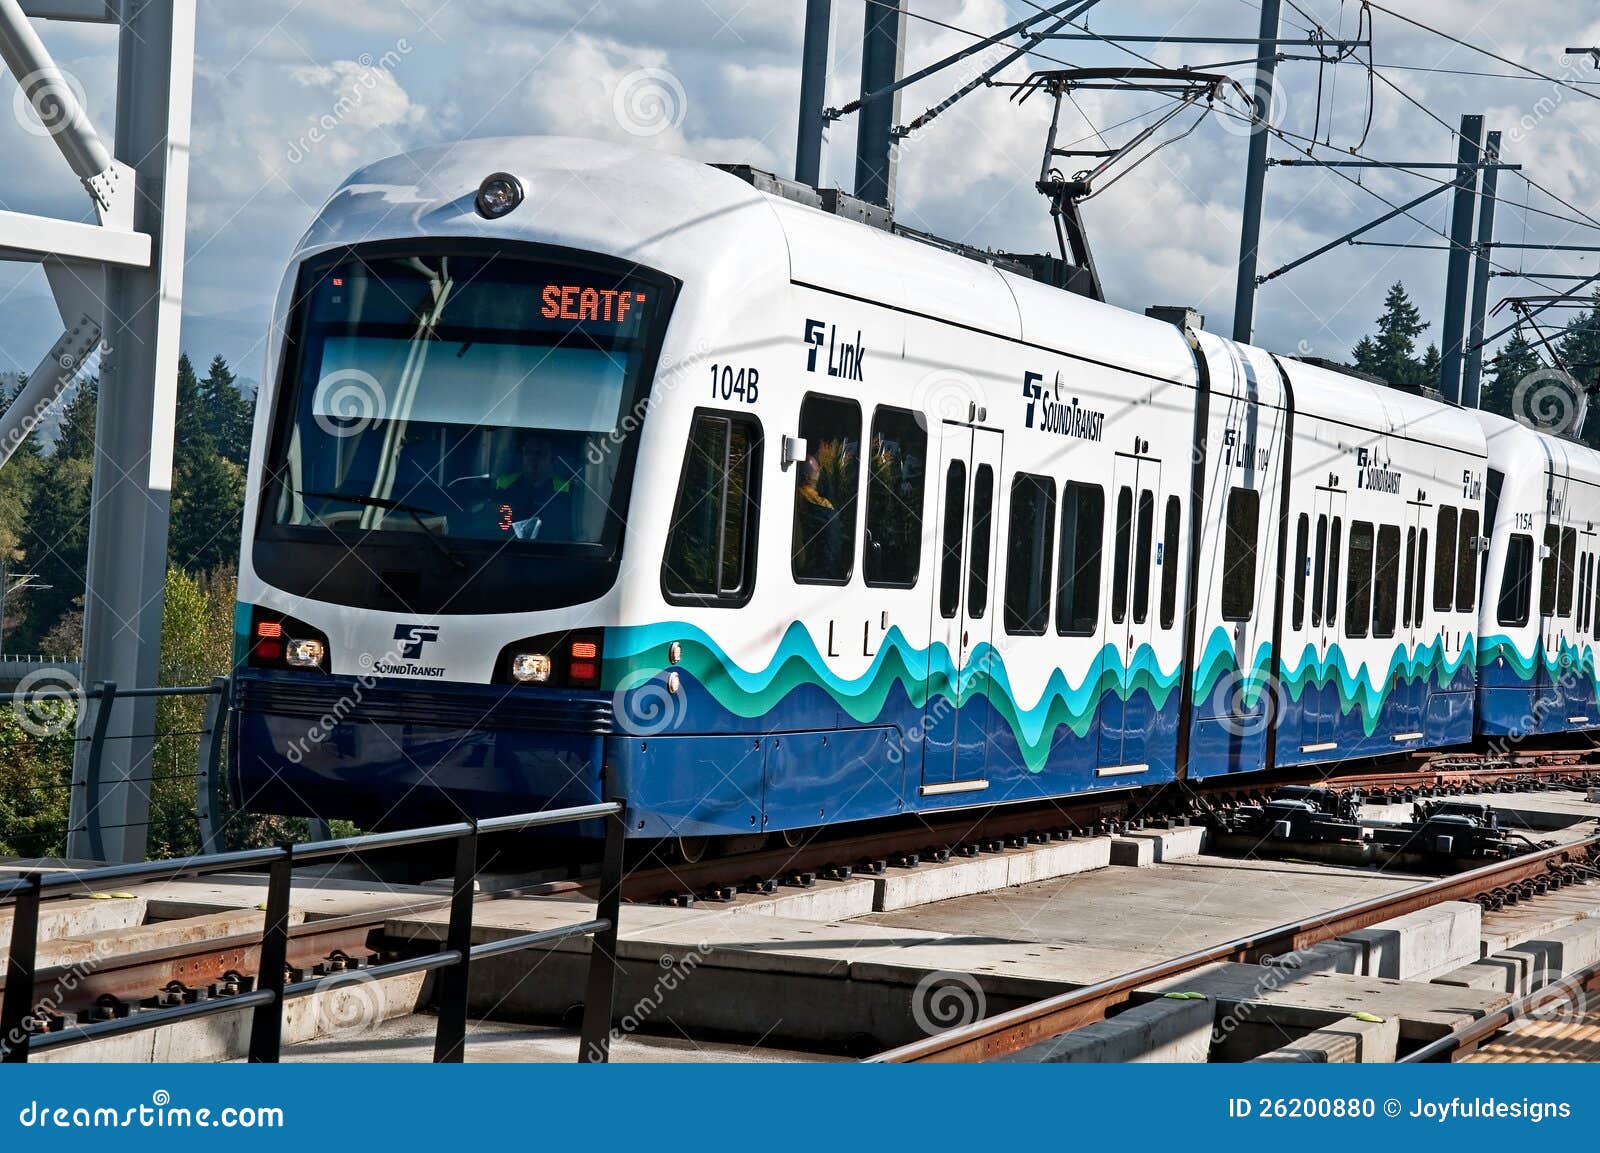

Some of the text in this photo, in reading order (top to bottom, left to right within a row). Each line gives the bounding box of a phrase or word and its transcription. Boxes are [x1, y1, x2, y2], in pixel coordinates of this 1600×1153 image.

[828, 324, 865, 381] Link
[711, 363, 759, 404] 104B
[498, 504, 513, 530] 3
[1516, 512, 1533, 531] 115A
